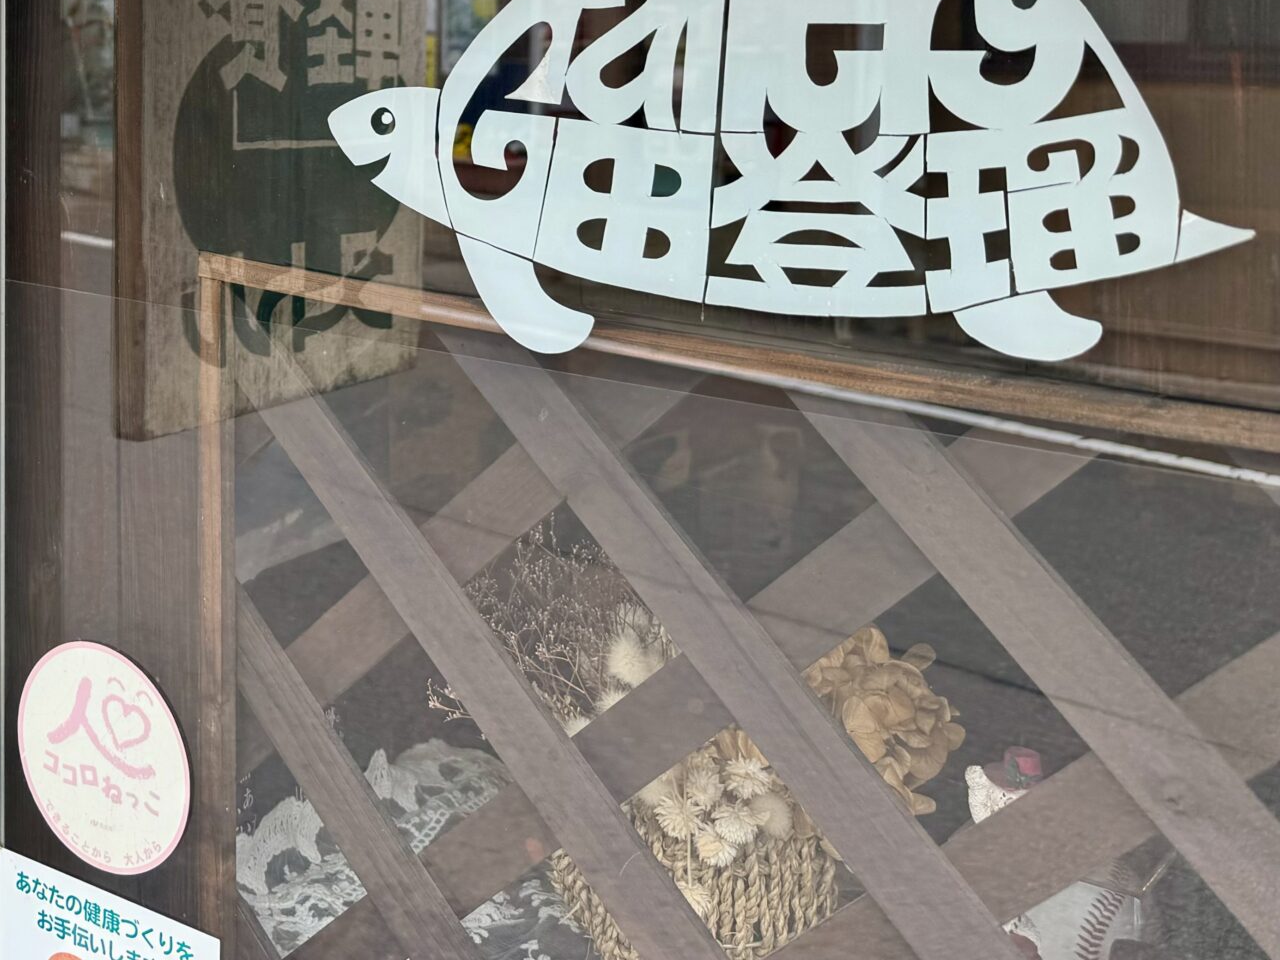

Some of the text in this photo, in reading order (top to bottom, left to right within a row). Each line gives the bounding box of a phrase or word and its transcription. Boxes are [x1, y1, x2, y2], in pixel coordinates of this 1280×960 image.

[42, 749, 161, 817] ココロねっこ
[15, 871, 195, 960] あなたの健康づくりを
